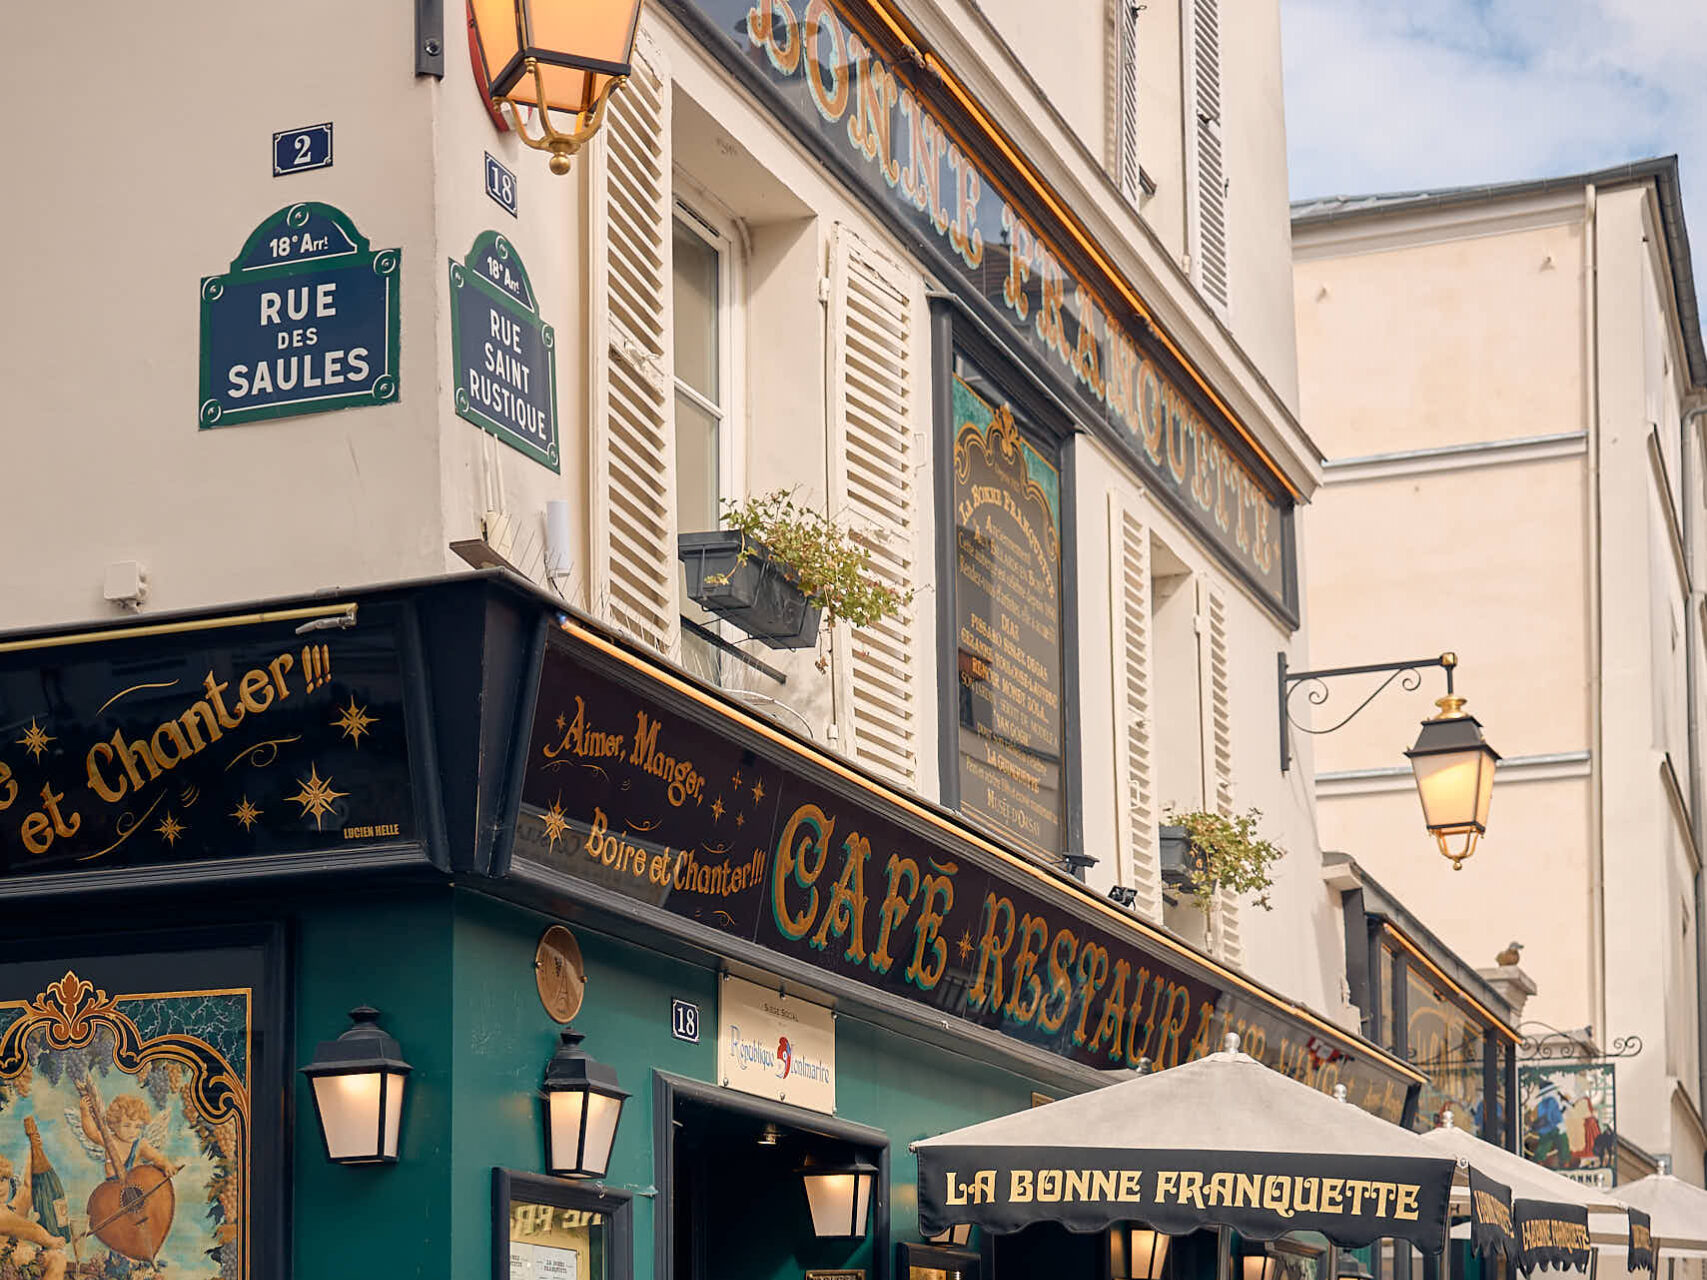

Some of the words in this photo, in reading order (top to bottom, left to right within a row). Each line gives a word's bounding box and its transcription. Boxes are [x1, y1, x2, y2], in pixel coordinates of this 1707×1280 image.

[294, 135, 312, 165] 2
[490, 164, 513, 205] 18
[261, 283, 337, 326] RUE
[747, 0, 983, 271] BONNE
[1002, 202, 1275, 576] FRANQUETTE
[277, 327, 318, 350] DES
[490, 309, 522, 355] RUE
[228, 347, 370, 399] SAULES
[485, 342, 530, 394] SAINT
[469, 368, 547, 441] RUSTIQUE
[543, 695, 626, 764] Aimer,
[21, 782, 81, 854] et
[343, 826, 374, 840] LUCIEN
[584, 806, 648, 877] Boire
[650, 846, 671, 886] et
[676, 1005, 696, 1037] 18
[945, 1170, 998, 1206] LA
[1008, 1168, 1142, 1204] BONNE
[1154, 1170, 1422, 1222] FRANQUETTE
